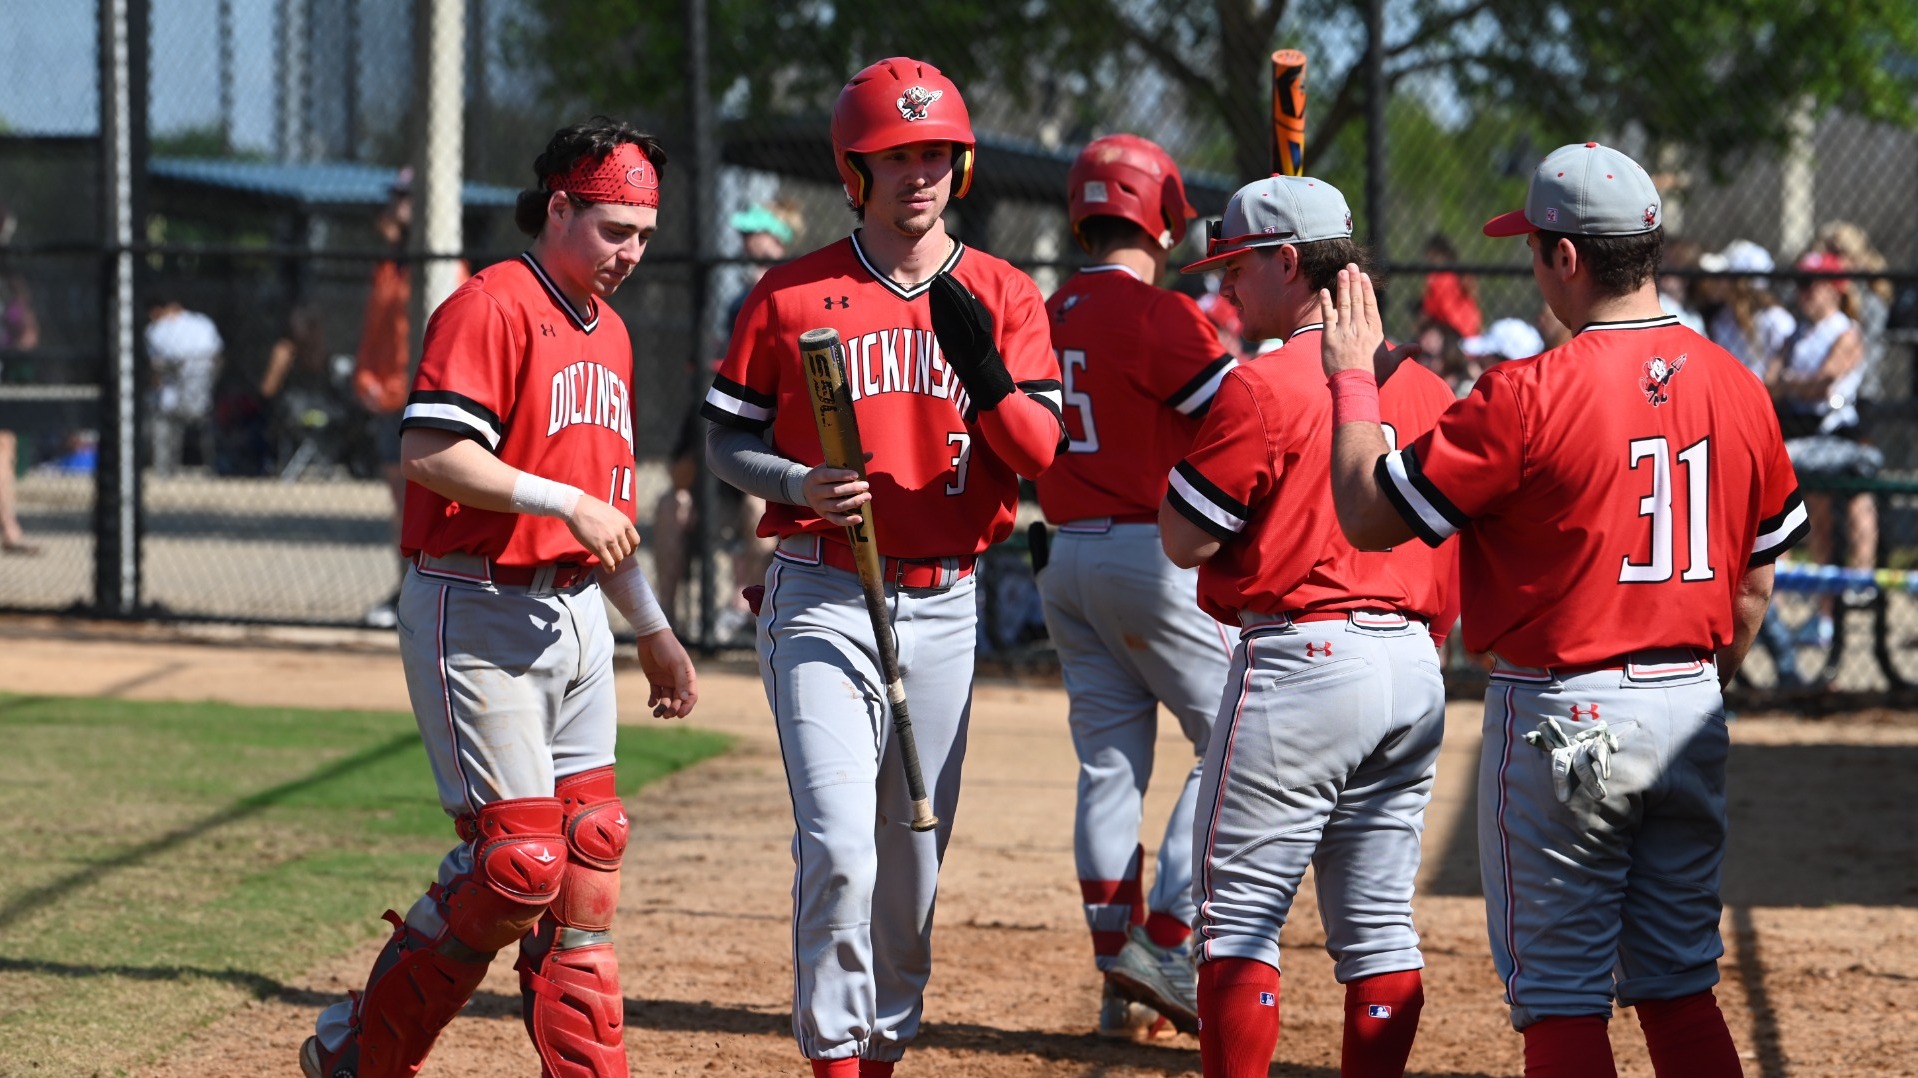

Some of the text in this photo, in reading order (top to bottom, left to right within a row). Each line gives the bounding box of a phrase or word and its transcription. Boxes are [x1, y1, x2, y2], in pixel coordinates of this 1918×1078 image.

[841, 327, 971, 420] ICKINS
[1053, 348, 1100, 453] 5
[945, 431, 971, 496] 3
[1617, 434, 1715, 584] 31
